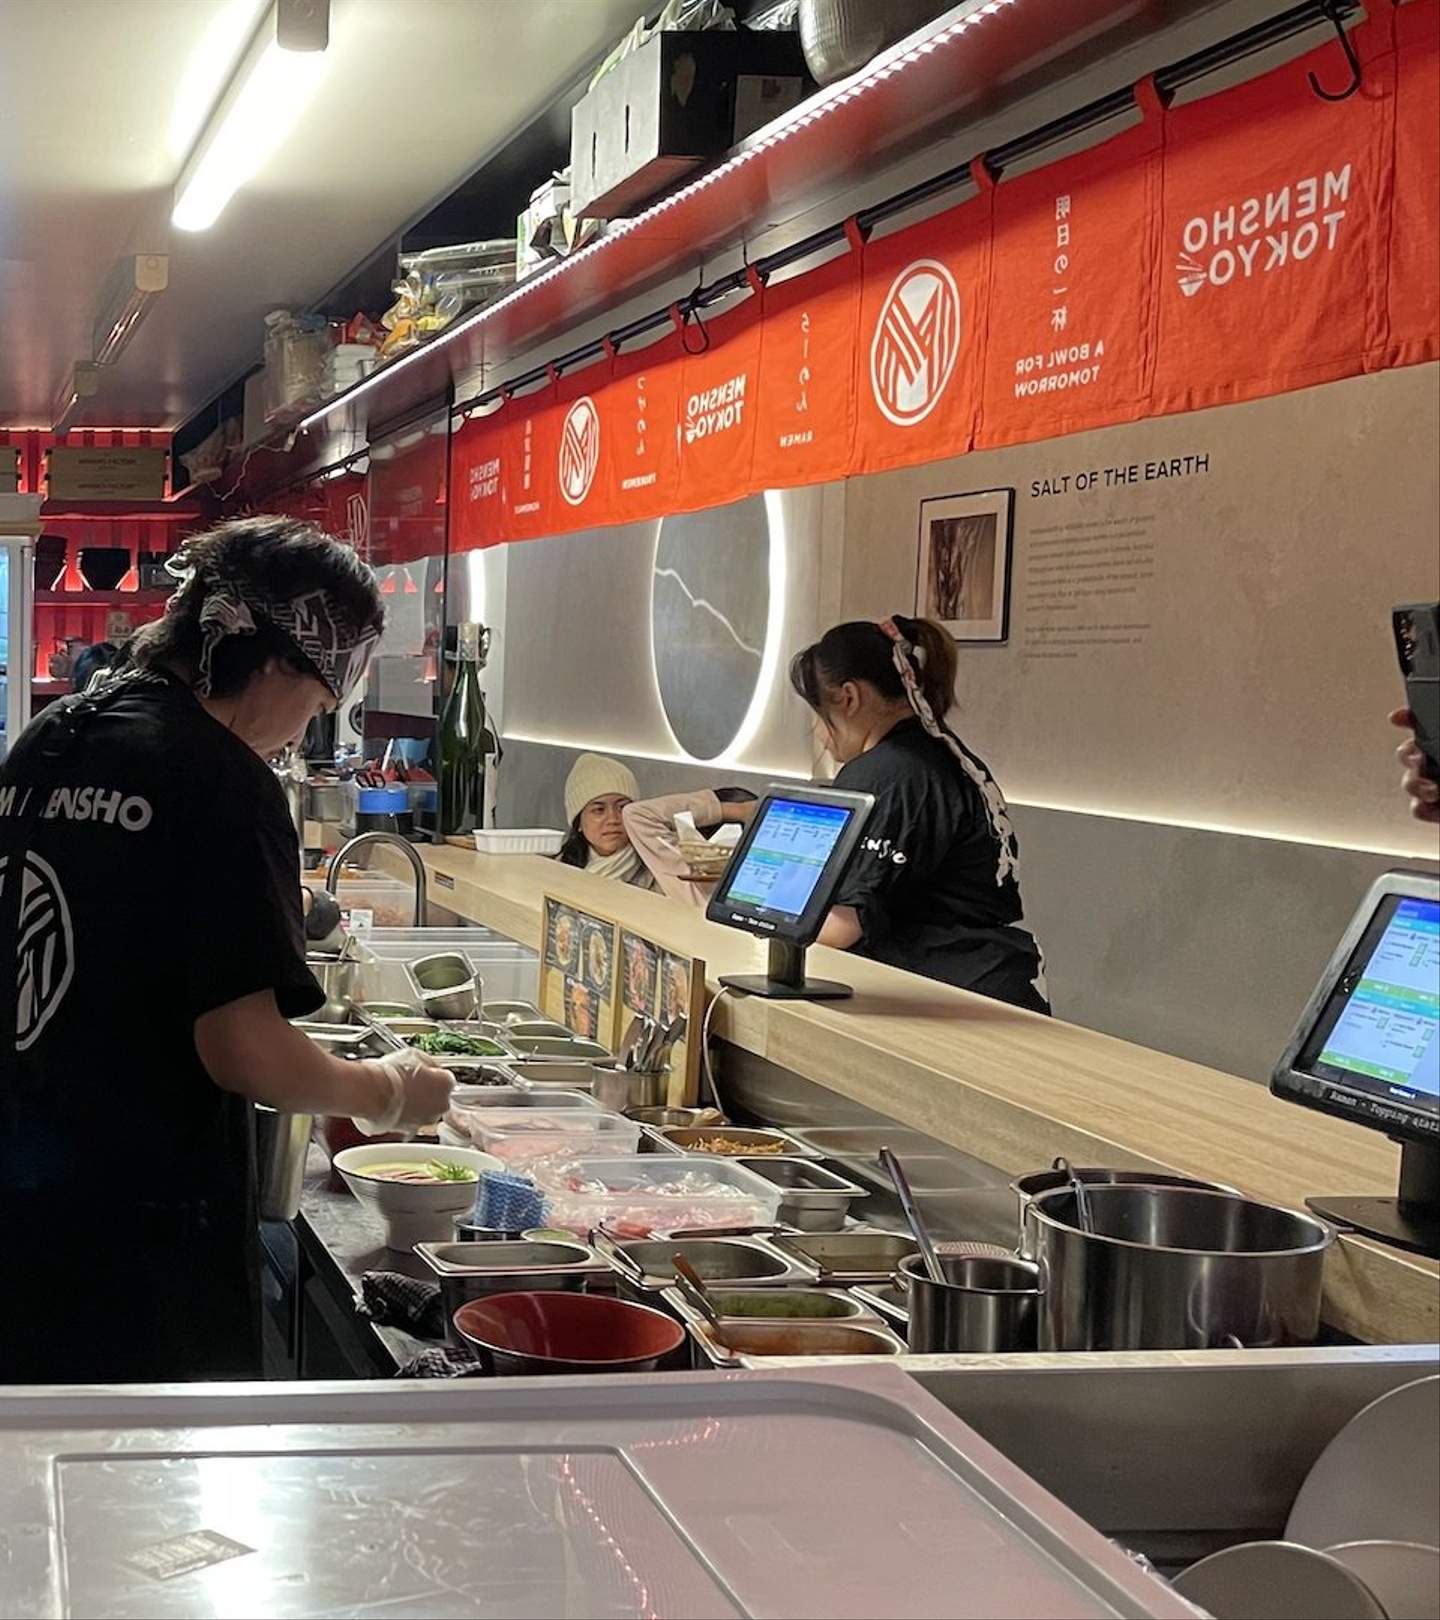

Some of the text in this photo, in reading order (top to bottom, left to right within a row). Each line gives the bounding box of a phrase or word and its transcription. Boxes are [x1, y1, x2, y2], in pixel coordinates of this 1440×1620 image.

[1031, 453, 1209, 498] SALT OF THE EARTH
